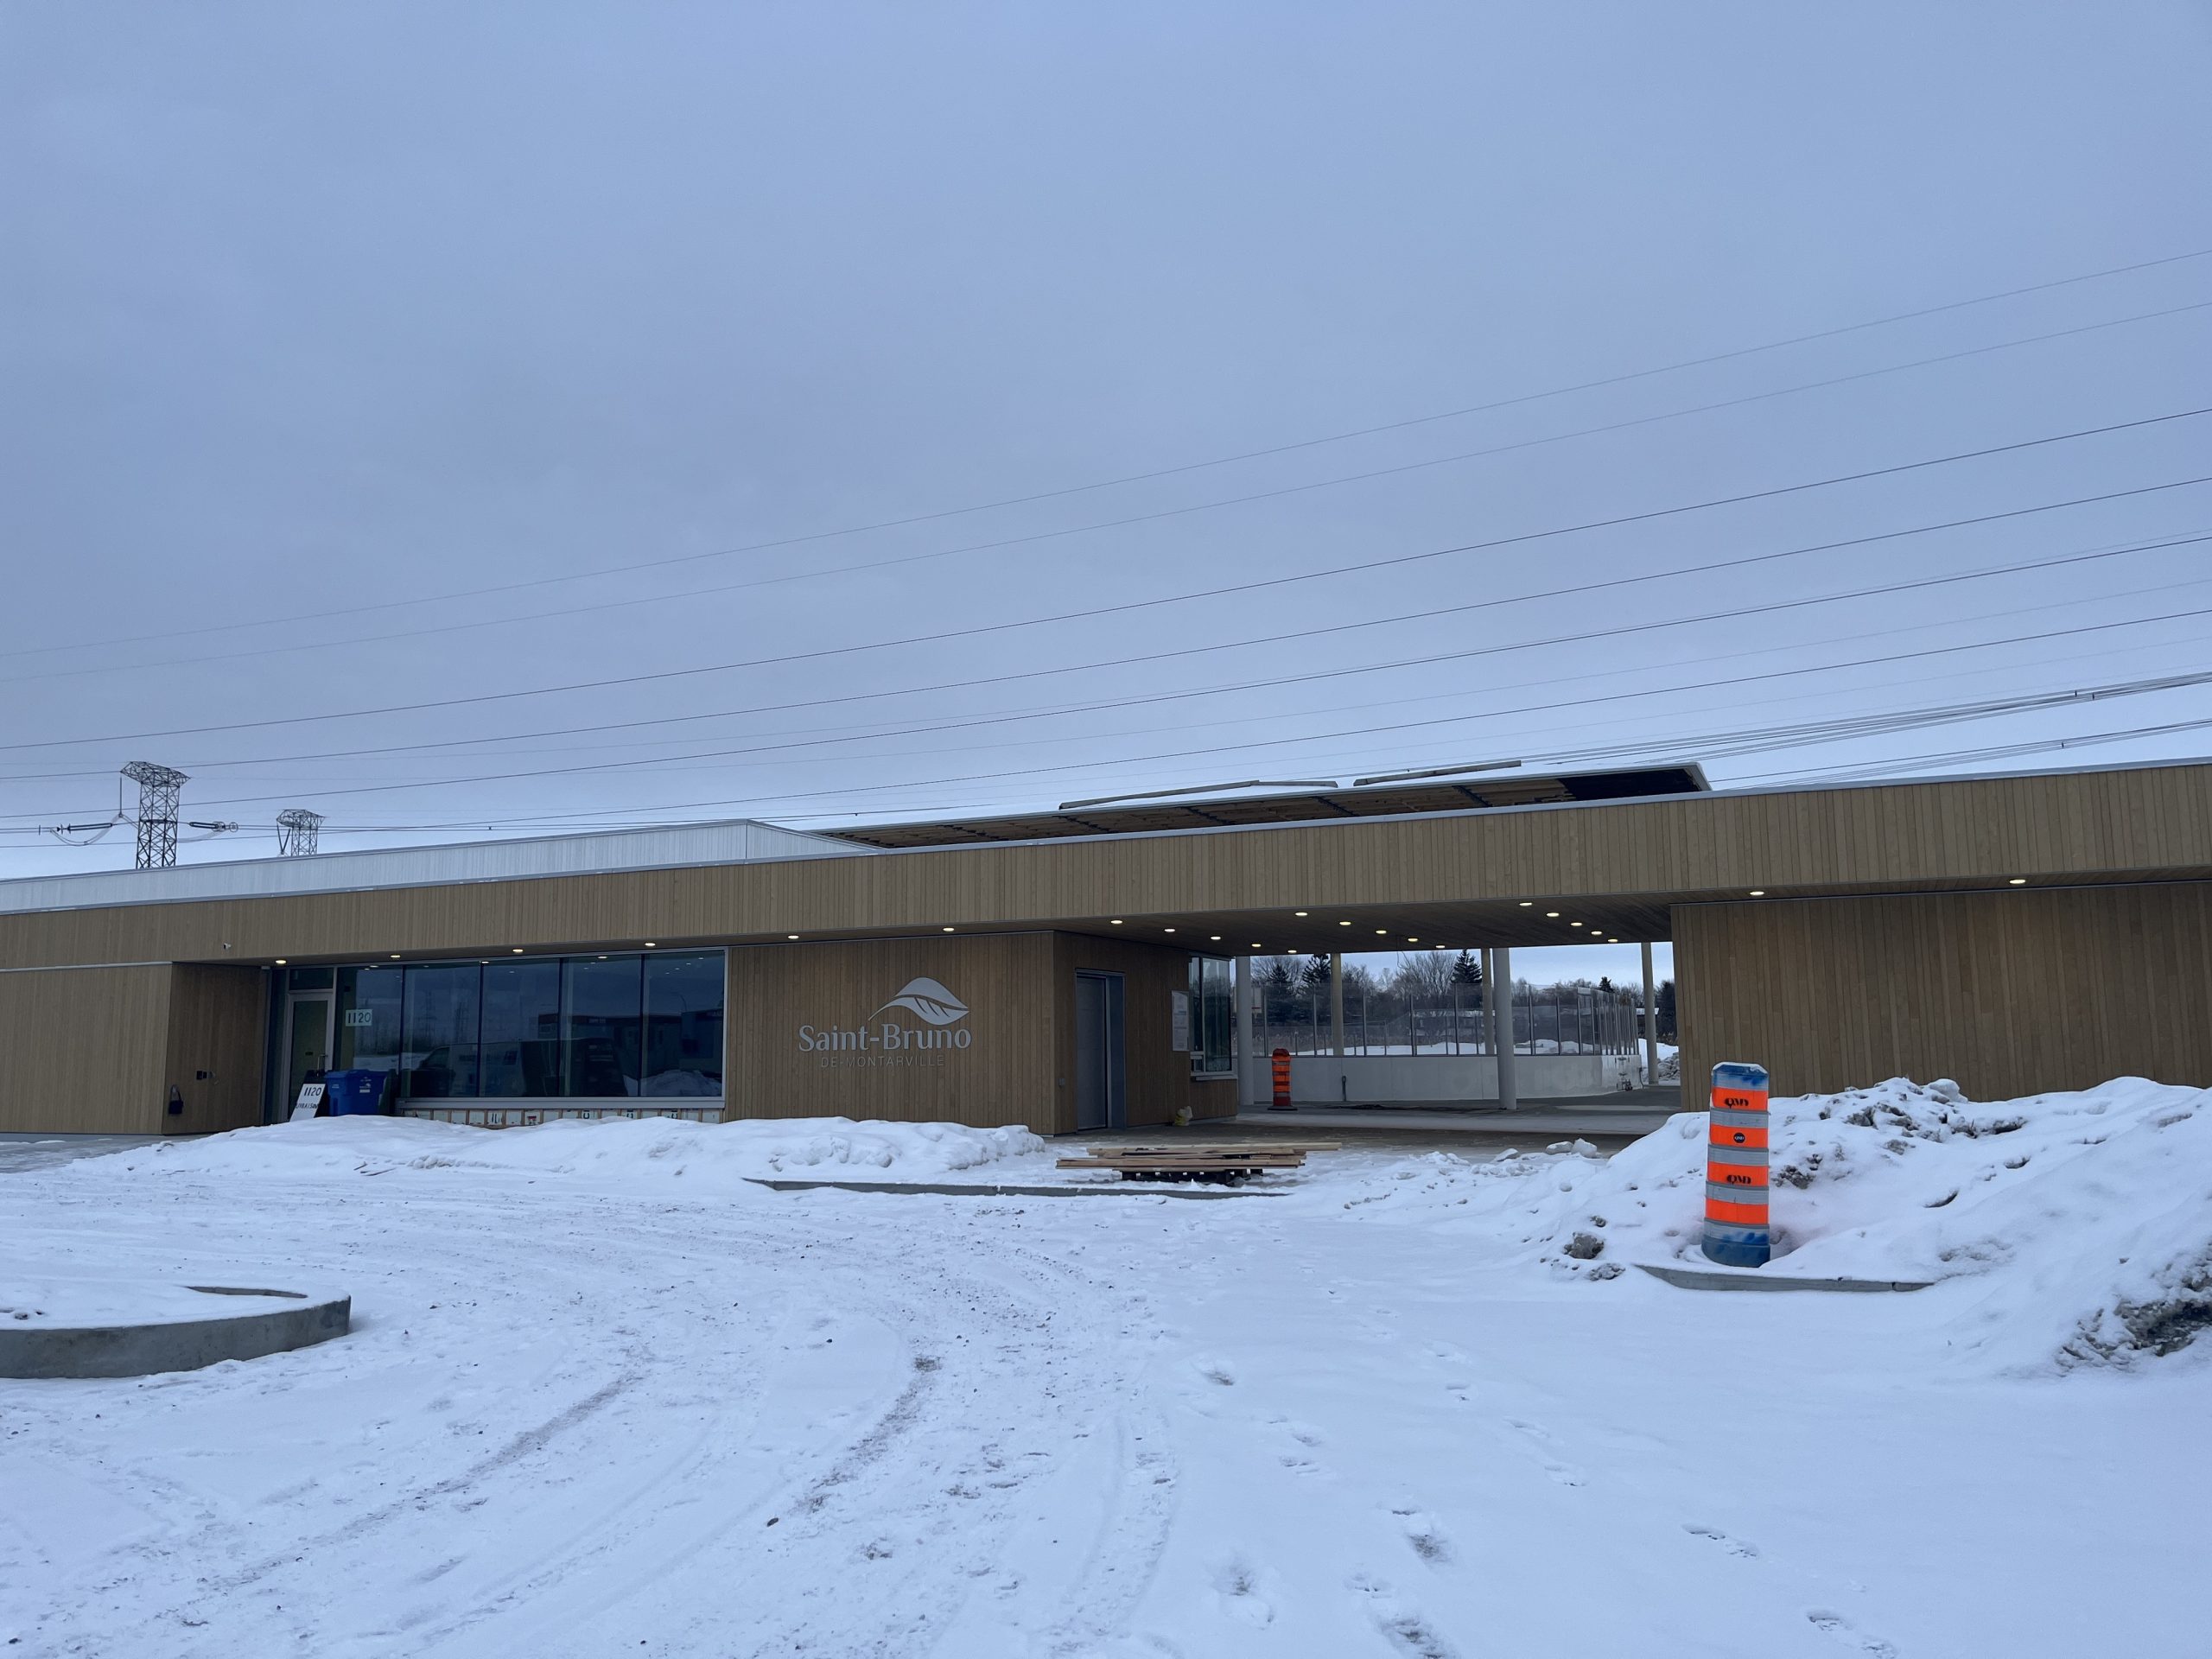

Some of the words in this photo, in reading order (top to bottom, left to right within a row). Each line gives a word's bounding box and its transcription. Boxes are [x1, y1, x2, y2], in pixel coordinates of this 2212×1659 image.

[347, 1012, 371, 1024] 1120
[798, 1023, 971, 1052] Saint-Bruno
[821, 1055, 944, 1068] DE-MONTARVILLE
[303, 1087, 322, 1096] 1120
